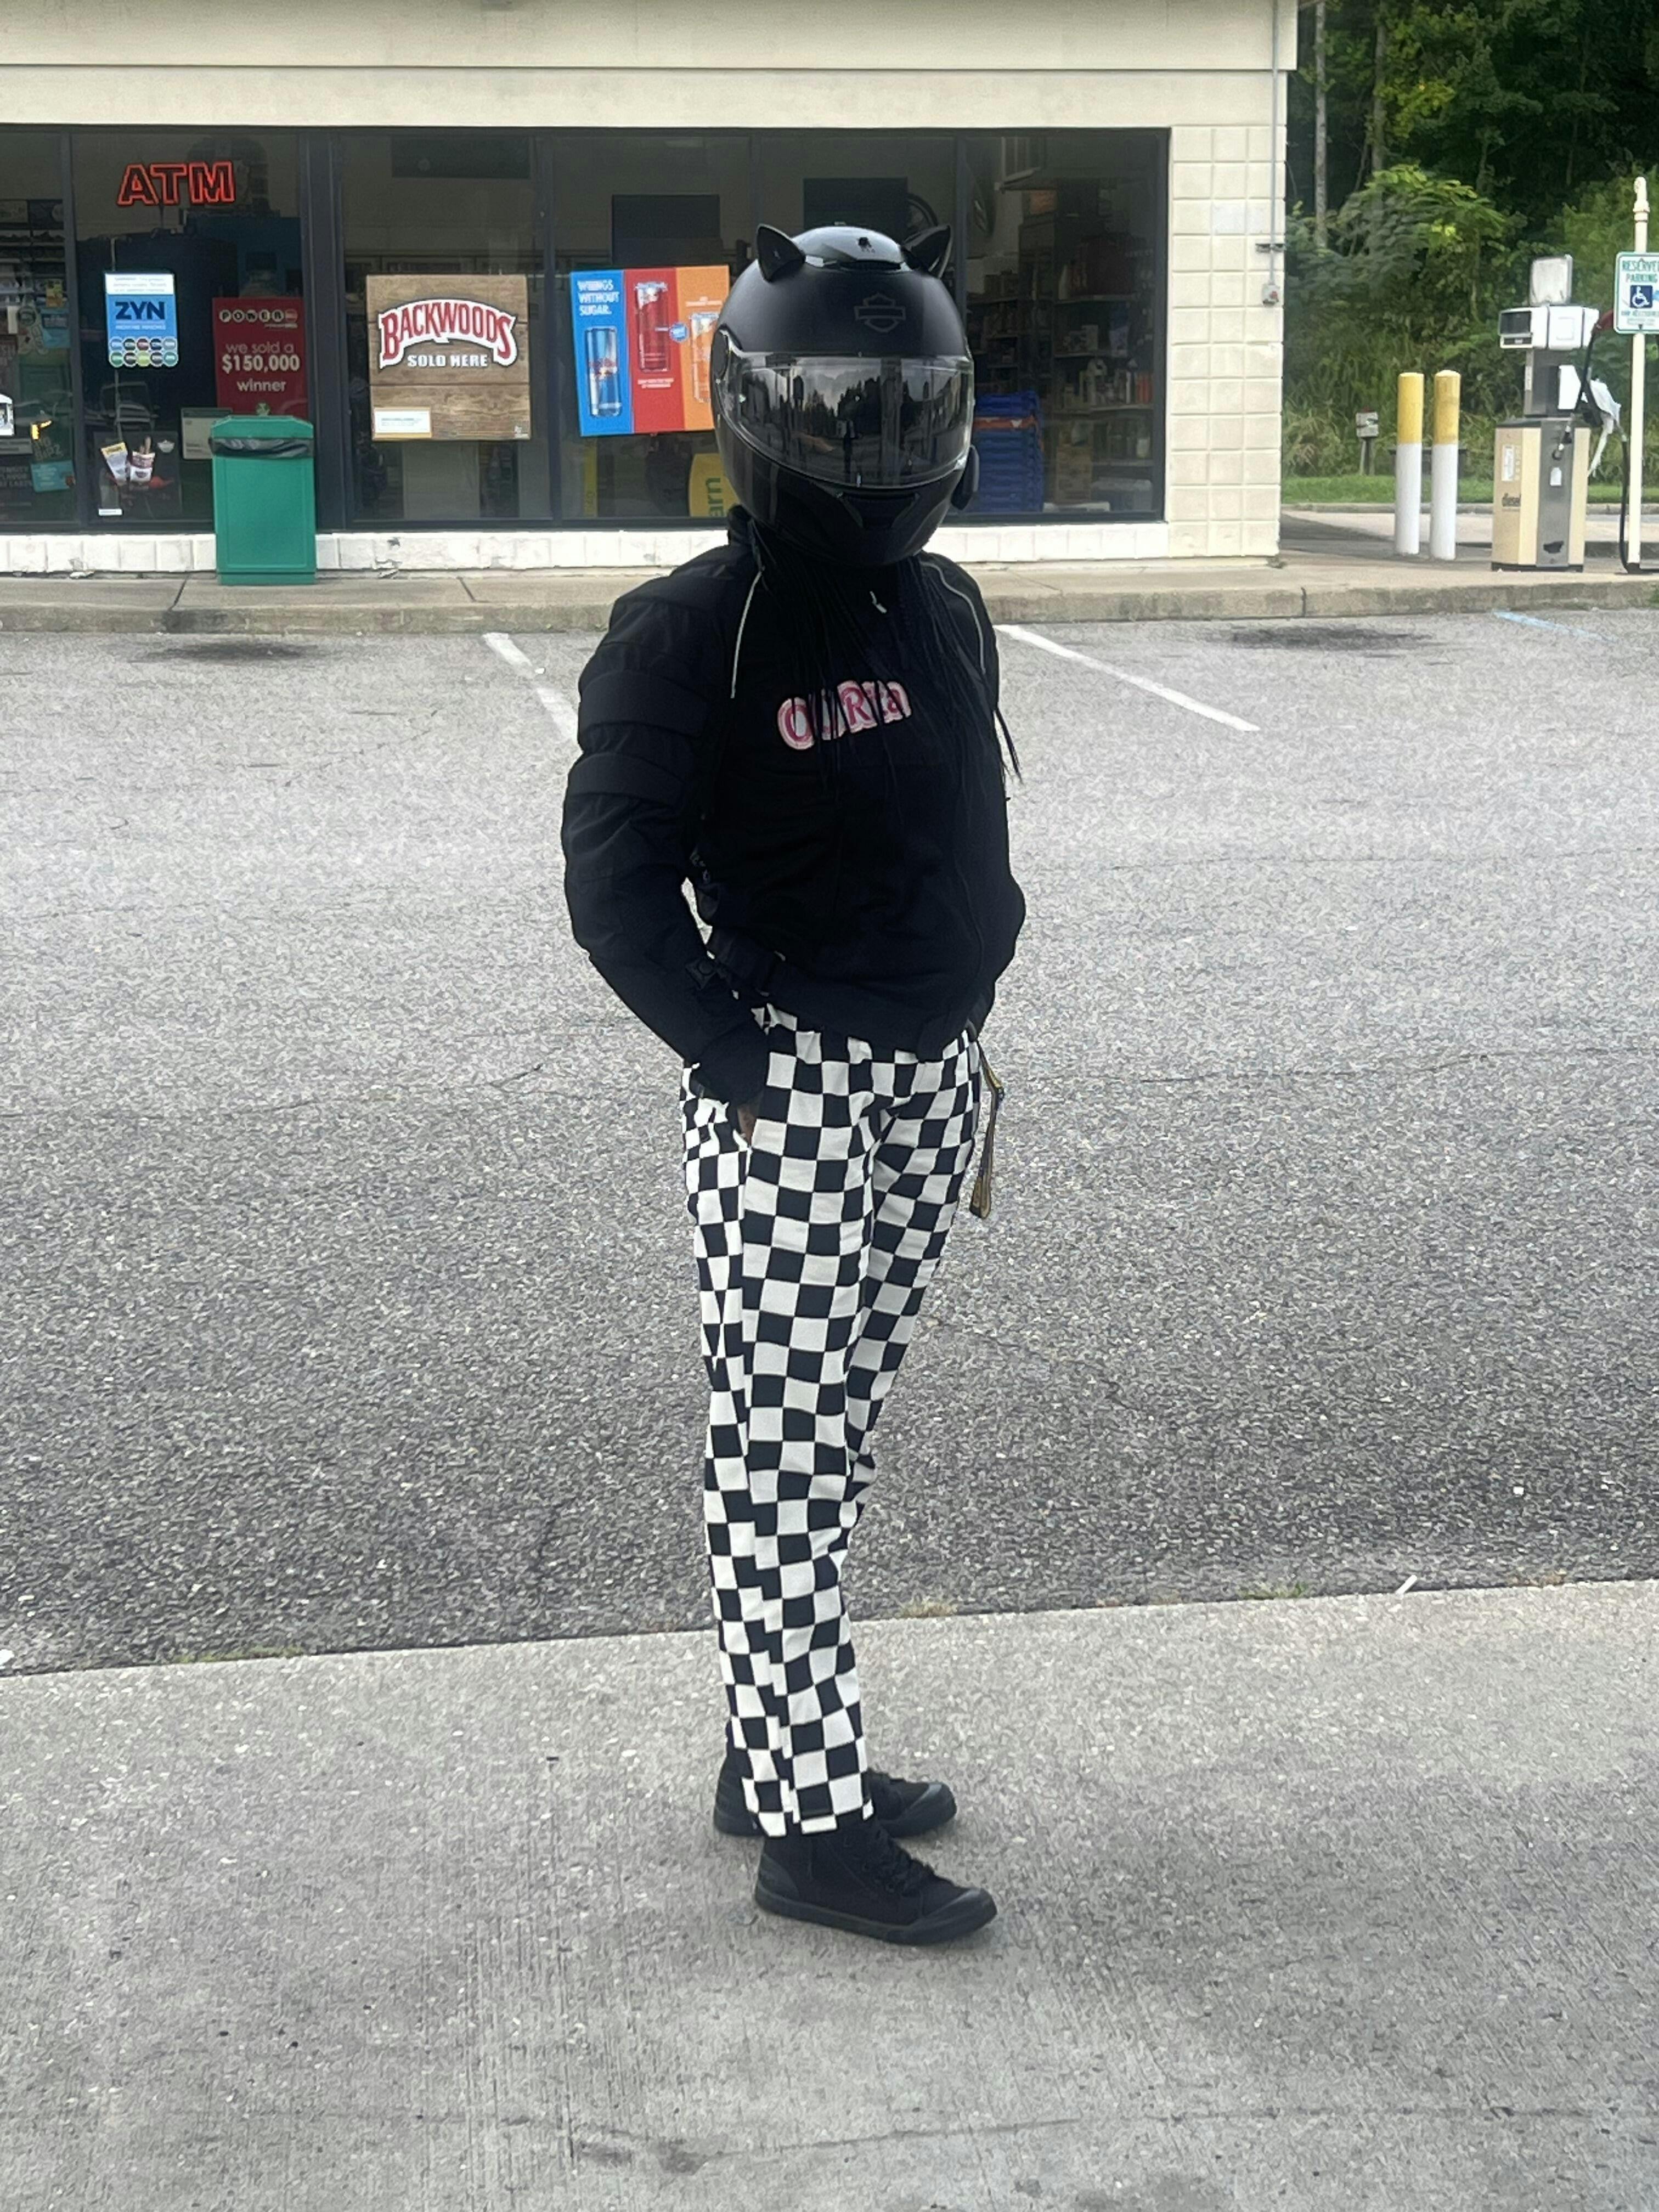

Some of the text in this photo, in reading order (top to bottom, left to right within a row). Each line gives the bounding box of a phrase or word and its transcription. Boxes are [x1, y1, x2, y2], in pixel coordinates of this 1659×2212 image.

[117, 161, 235, 205] ATM
[115, 301, 166, 319] ZYN
[380, 301, 514, 364] BACKWOODS
[225, 341, 294, 354] we sold a
[222, 354, 300, 374] $150,000
[407, 354, 488, 367] SOLD HERE
[237, 378, 286, 392] winner
